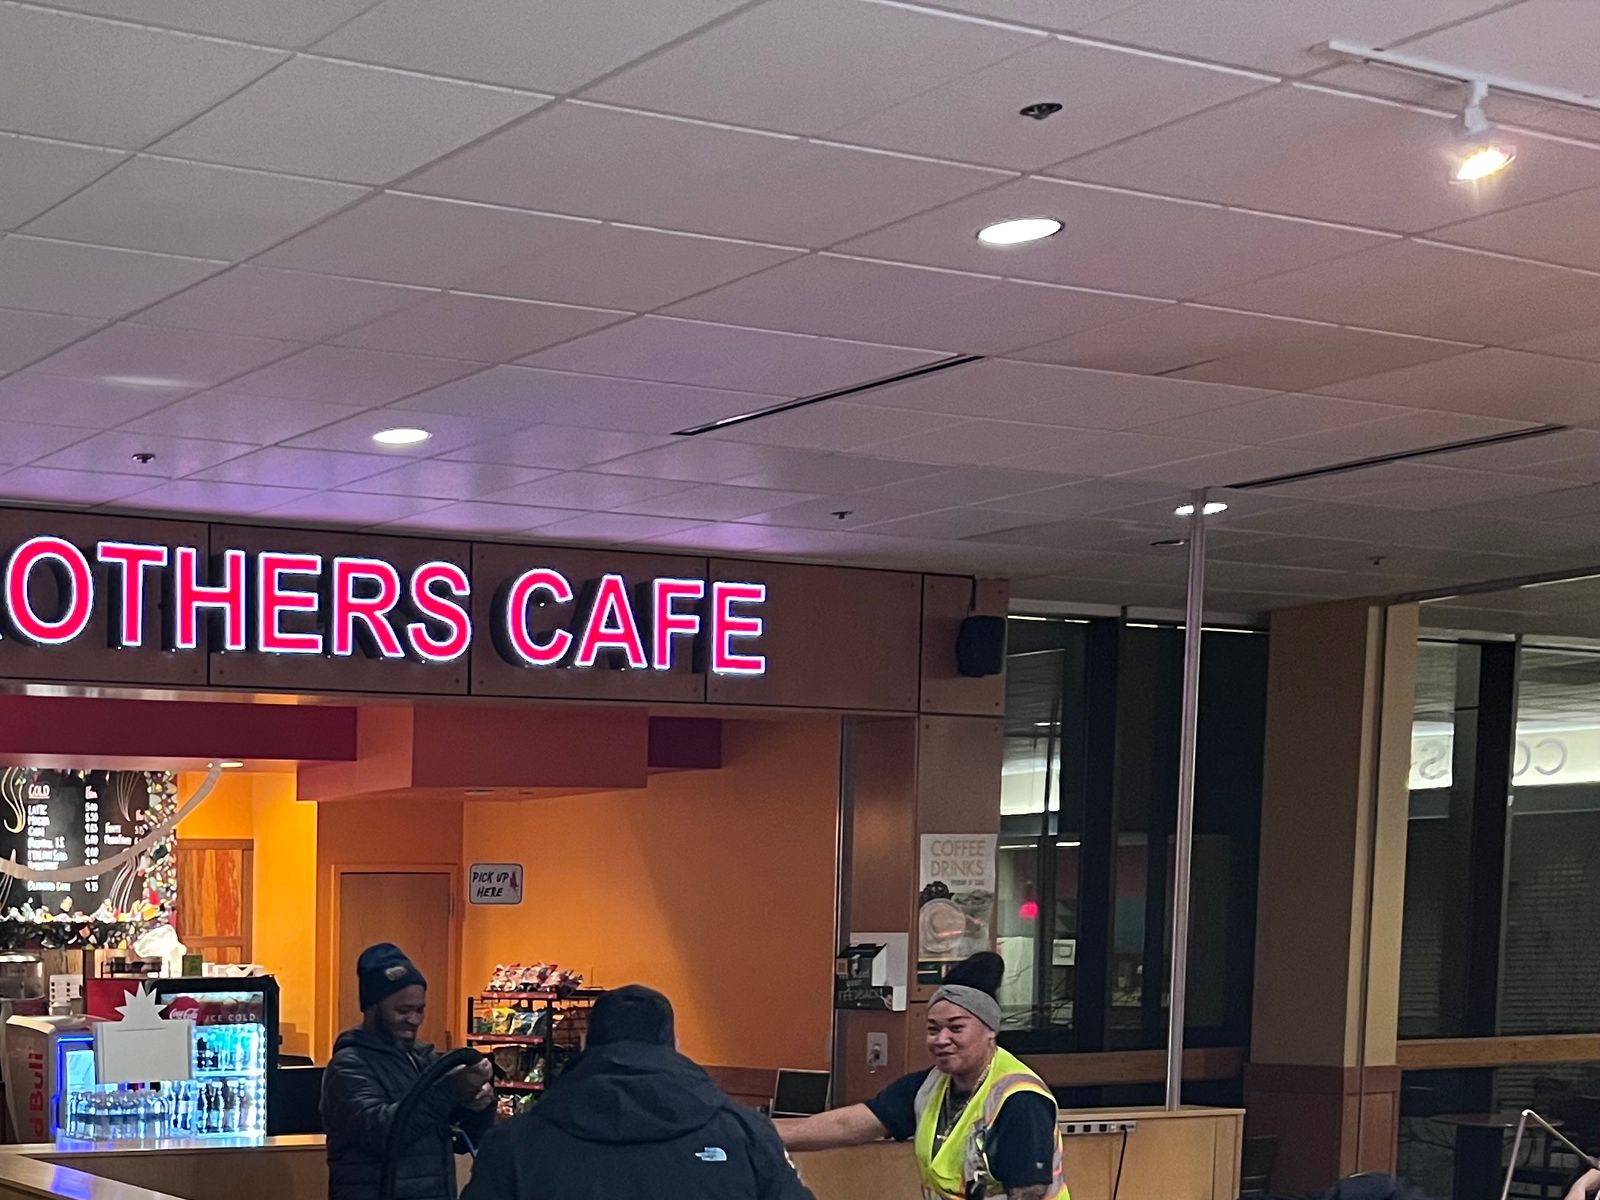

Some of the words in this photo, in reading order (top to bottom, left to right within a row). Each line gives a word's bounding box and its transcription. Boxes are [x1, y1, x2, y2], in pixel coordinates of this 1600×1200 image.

[506, 568, 767, 675] CAFE
[930, 839, 986, 857] COFFEE
[930, 860, 985, 877] DRINKS
[472, 871, 494, 884] PICK
[496, 871, 510, 883] UP
[476, 887, 504, 898] HERE
[228, 1013, 256, 1022] COLD
